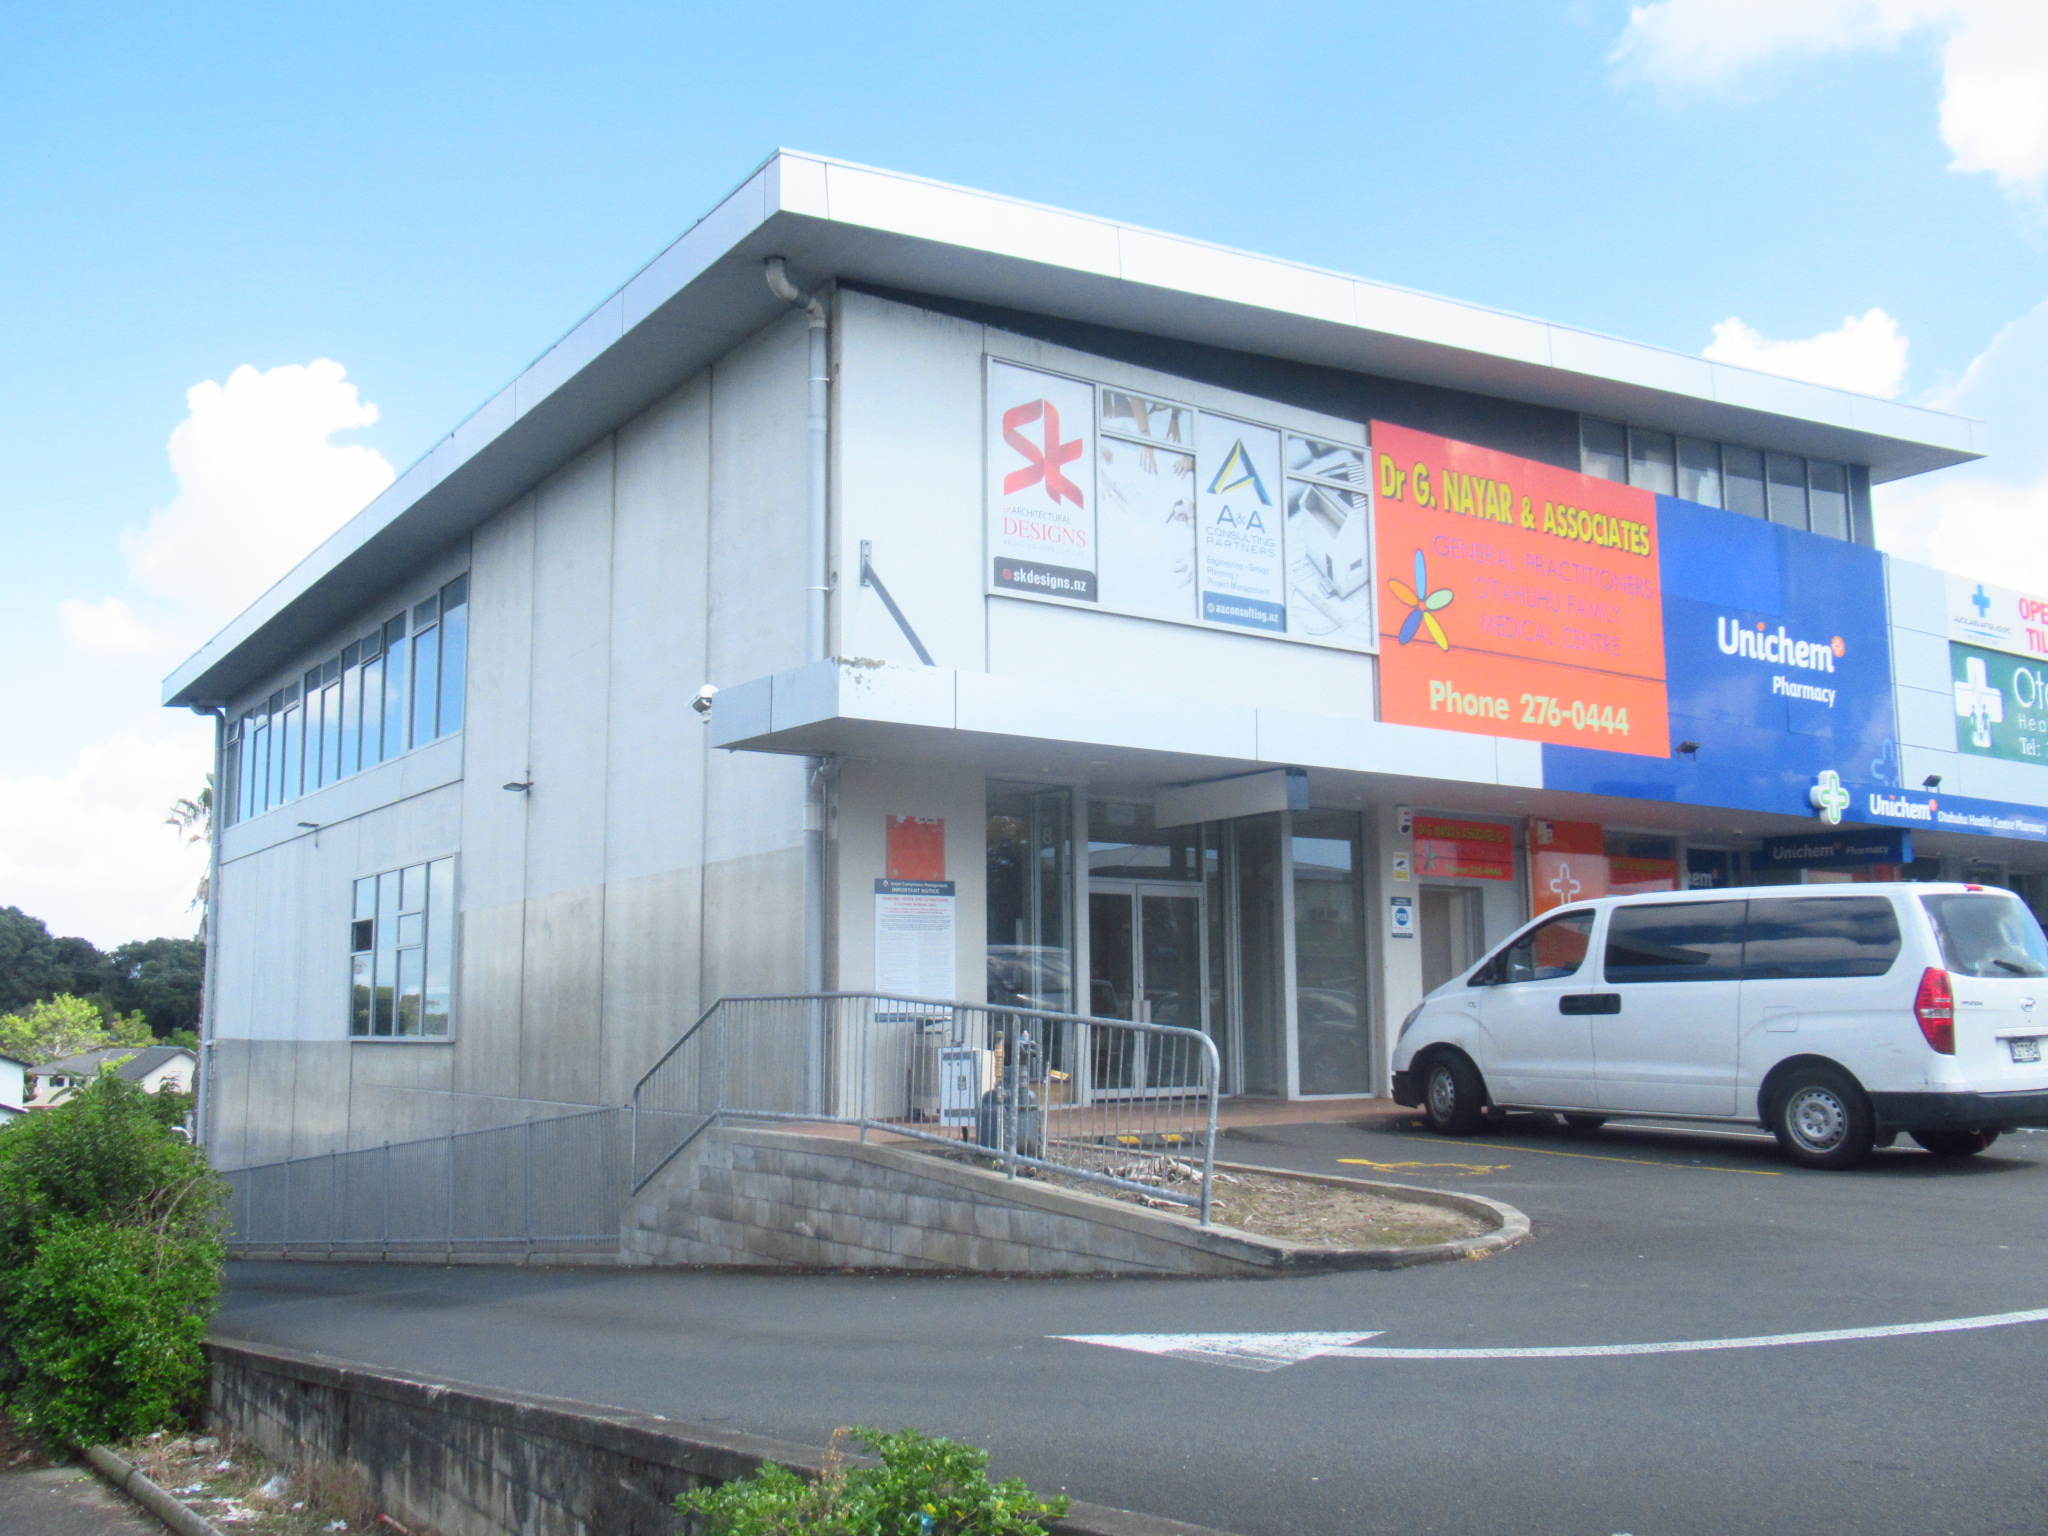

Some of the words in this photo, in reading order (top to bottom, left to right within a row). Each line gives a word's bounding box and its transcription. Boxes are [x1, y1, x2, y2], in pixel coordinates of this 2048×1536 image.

[1380, 454, 1405, 500] Dr
[1412, 462, 1437, 508] G.
[1443, 469, 1514, 525] NAYAR
[1521, 496, 1537, 530] &
[1543, 501, 1650, 557] ASSOCIATES
[1003, 517, 1087, 548] DESIGNS
[1206, 526, 1276, 548] CONSULTING
[1206, 537, 1276, 558] PARTNERS
[1207, 555, 1243, 572] Engineering
[1249, 563, 1270, 576] Design
[1207, 566, 1234, 580] Planning
[1433, 535, 1517, 571] GENERAL
[1524, 553, 1653, 599] PRACTITIONERS
[1013, 568, 1087, 591] skdesigns.nz
[1207, 577, 1230, 590] Project
[1230, 582, 1270, 596] Management
[1216, 604, 1279, 623] aaconsulting.nz
[1473, 578, 1560, 613] OTAHUHU
[1567, 596, 1621, 625] FAMILY
[1479, 614, 1554, 645] MEDICAL
[1561, 627, 1621, 656] CENTRE
[1717, 616, 1835, 673] Unichem
[1772, 675, 1836, 708] Pharmacy
[1430, 680, 1509, 720] Phone
[1520, 693, 1629, 736] 276-0444
[2019, 737, 2041, 757] Tel:
[1870, 793, 1932, 820] Unichem
[1937, 811, 1968, 825] Otahuhu
[1969, 814, 1992, 828] Health
[1993, 817, 2015, 830] Centre
[2015, 820, 2047, 836] Pharmacy
[1772, 844, 1834, 860] Unichem
[1845, 845, 1889, 856] Pharmacy
